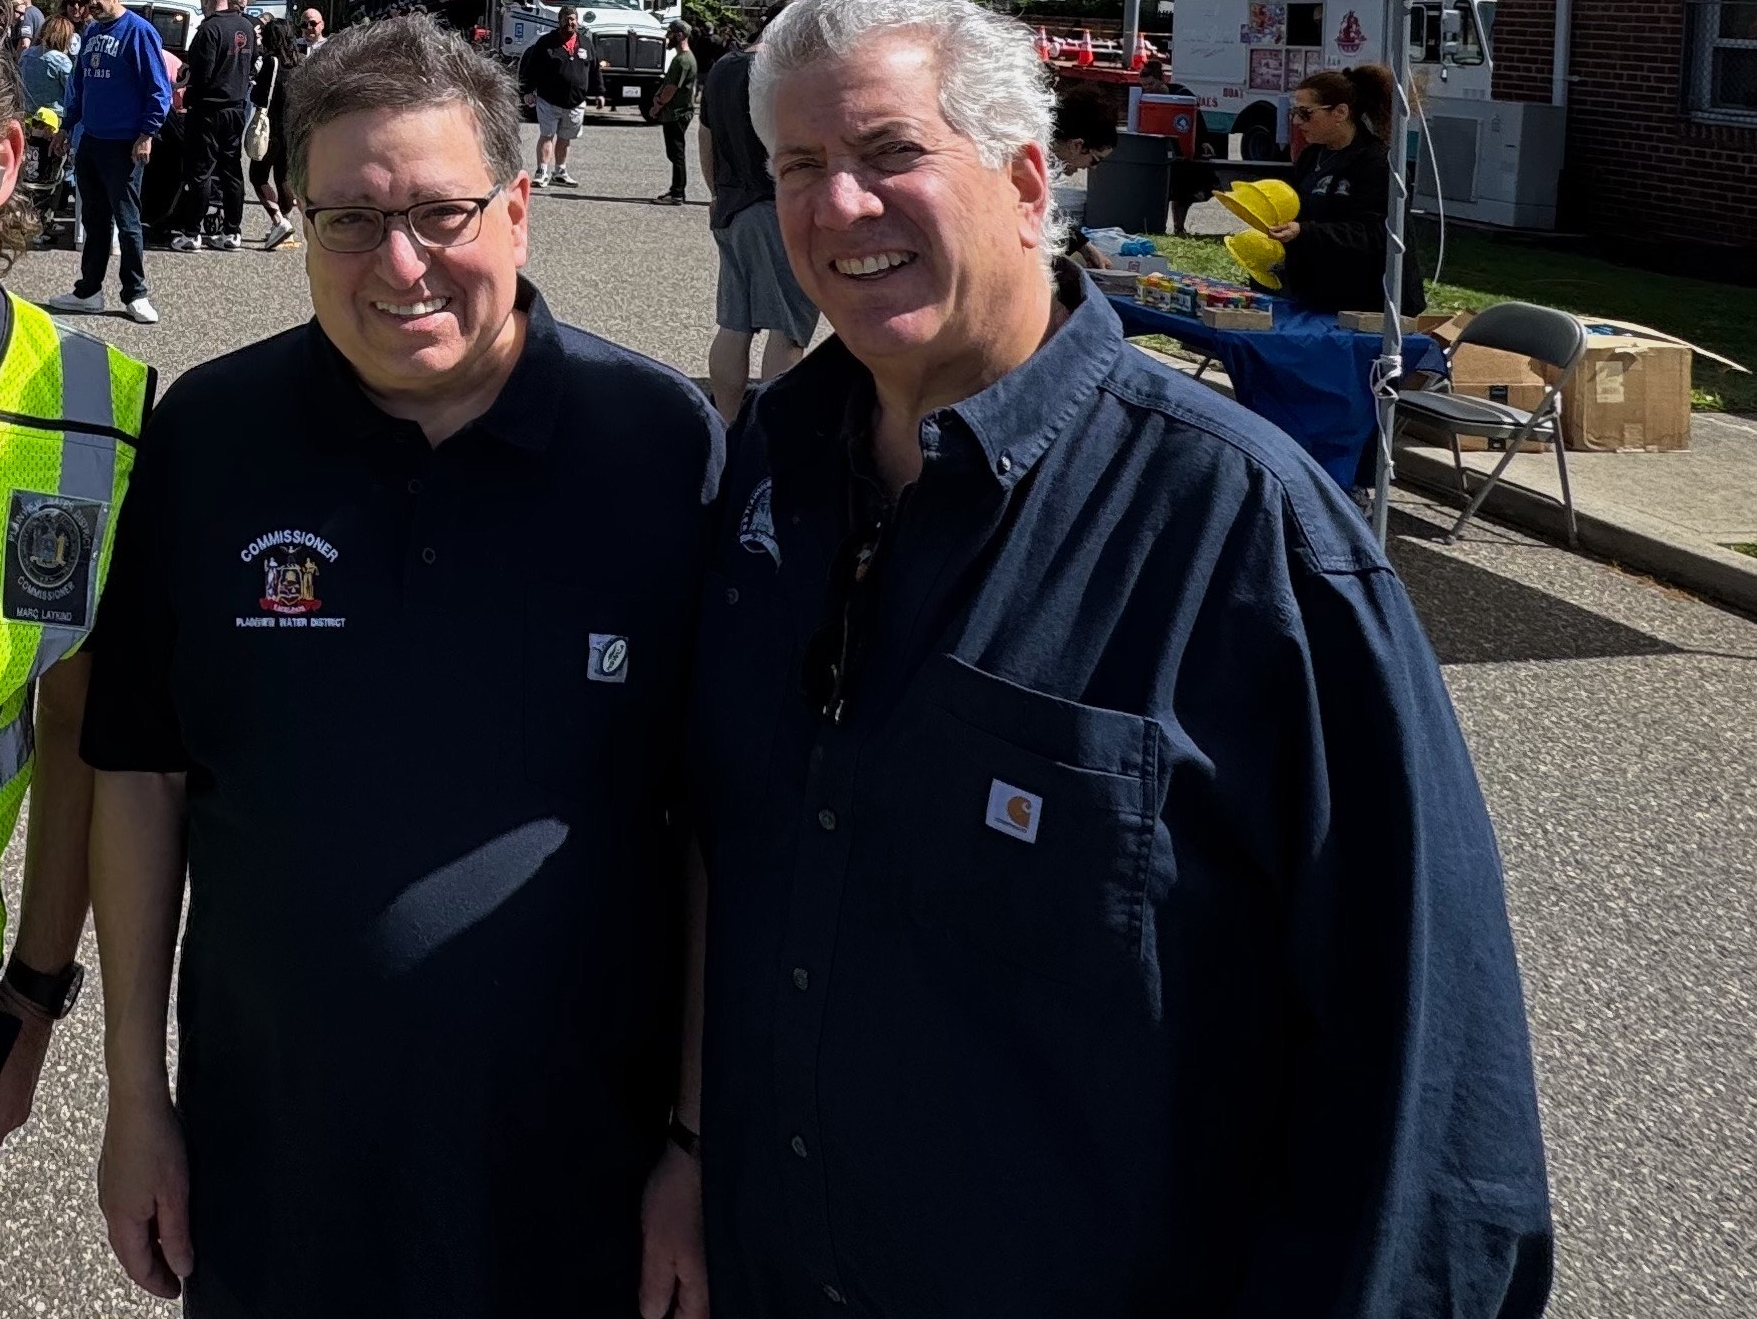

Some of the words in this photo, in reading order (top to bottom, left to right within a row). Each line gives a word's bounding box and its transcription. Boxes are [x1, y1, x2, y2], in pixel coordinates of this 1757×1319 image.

[240, 529, 339, 563] COMMISSIONER
[17, 576, 75, 601] COMMISSIONER
[17, 607, 39, 619] MARC
[278, 617, 307, 628] WATER
[310, 617, 346, 628] DISTRICT
